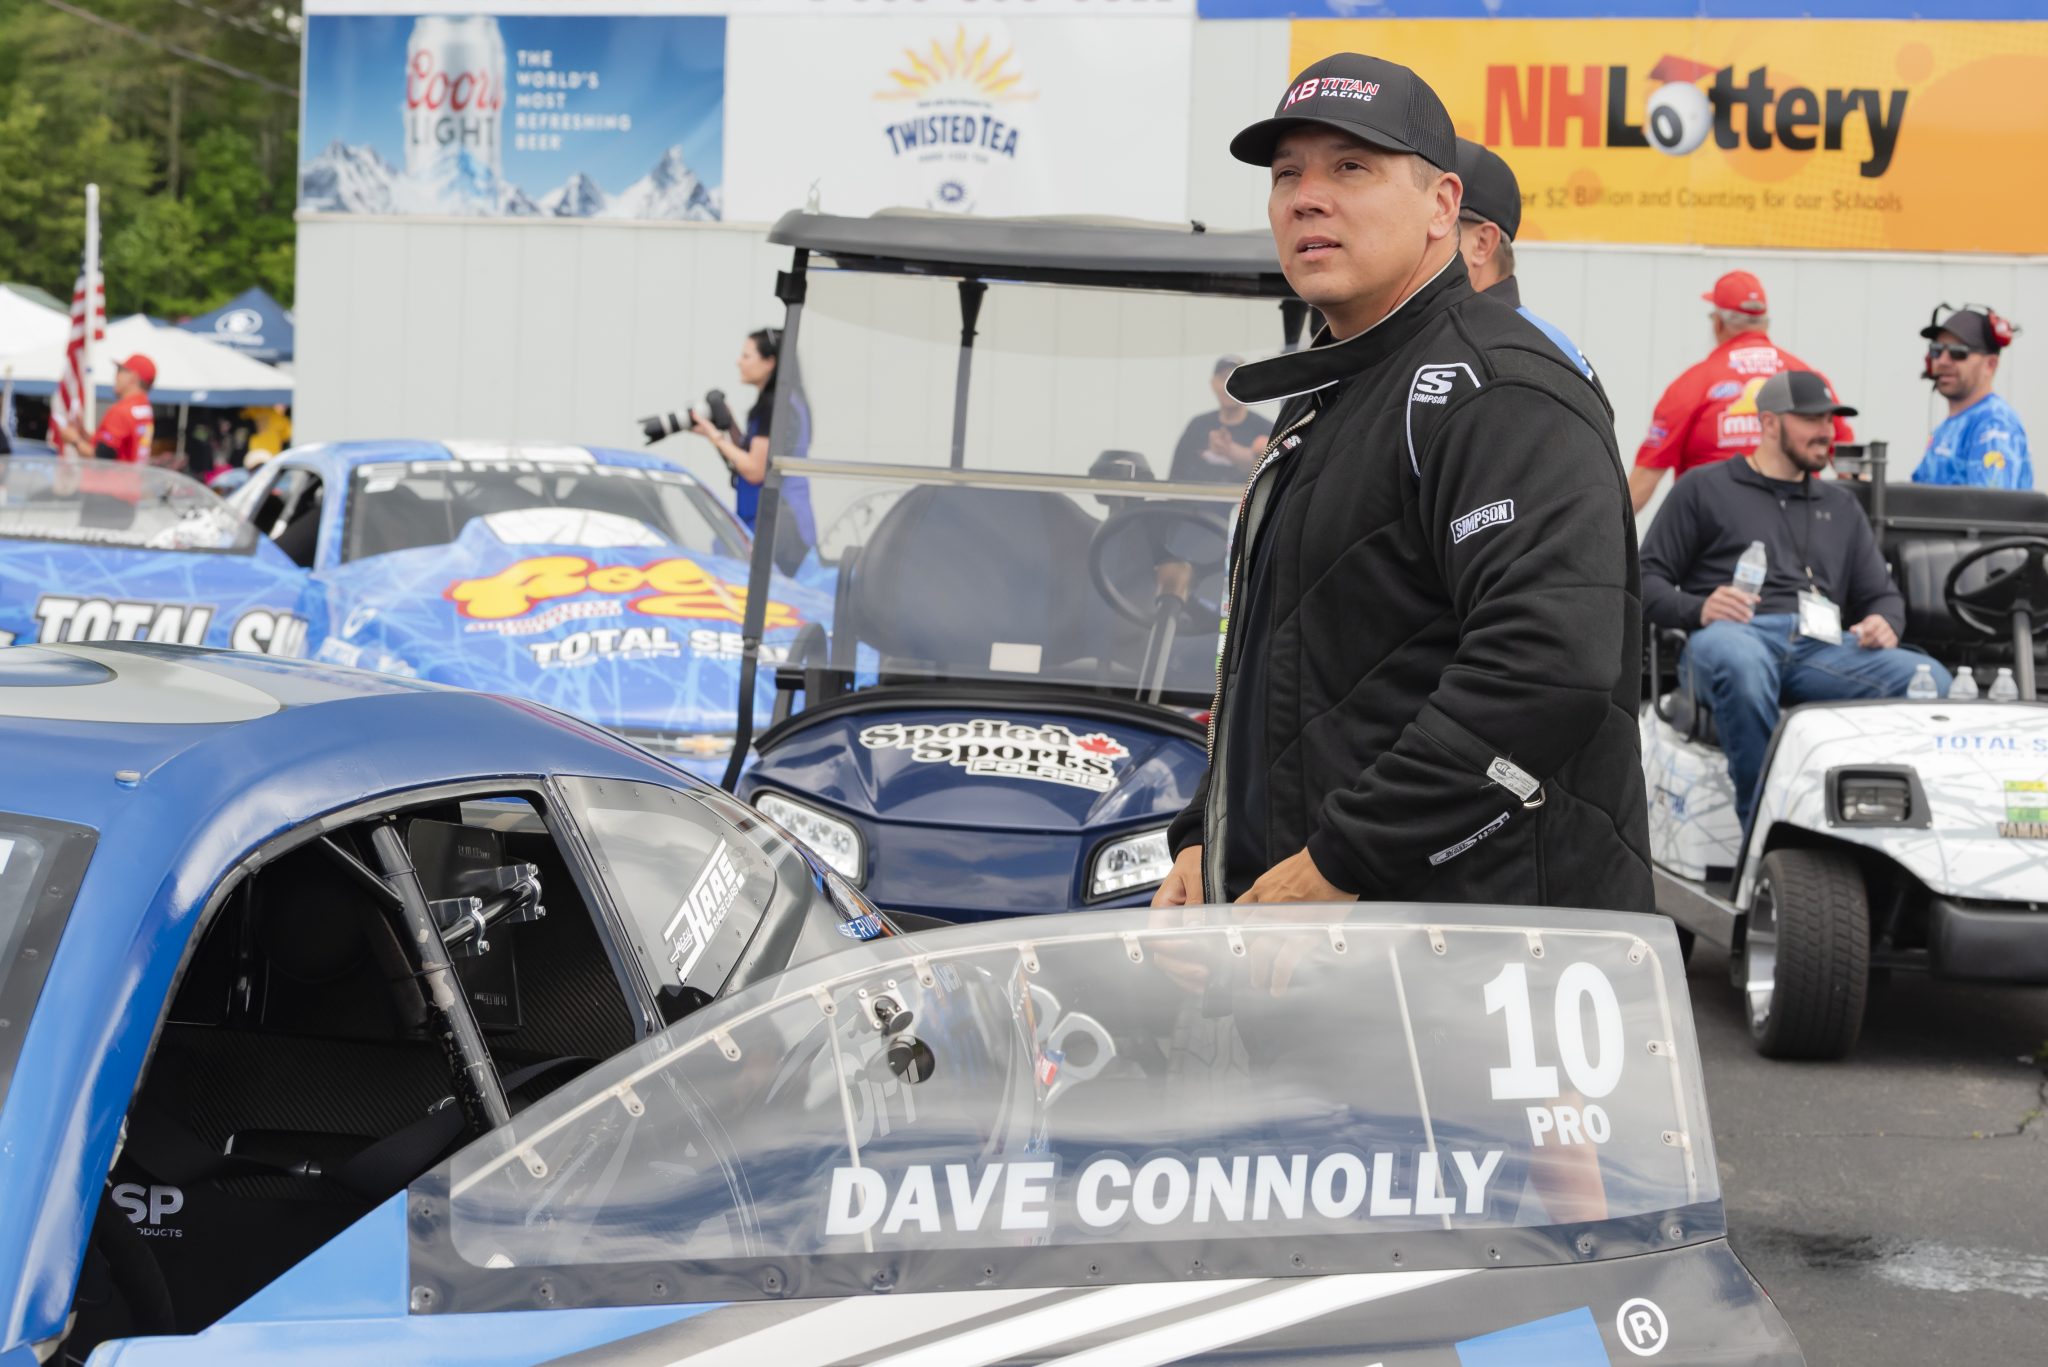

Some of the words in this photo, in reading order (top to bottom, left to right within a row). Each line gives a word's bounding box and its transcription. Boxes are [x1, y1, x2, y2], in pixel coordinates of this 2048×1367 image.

[517, 50, 552, 68] THE
[516, 71, 599, 89] WORLD'S
[1284, 77, 1320, 111] KB
[1321, 77, 1380, 96] TITAN
[516, 92, 566, 109] MOST
[1321, 90, 1372, 102] RACING
[410, 115, 496, 147] LIGHT
[516, 112, 631, 131] REFRESHING
[886, 115, 976, 156] TWISTED
[981, 115, 1018, 158] TEA
[515, 134, 561, 151] BEER
[1545, 187, 1568, 208] $2
[1639, 189, 1671, 209] and
[1832, 188, 1903, 212] Schools
[1412, 393, 1448, 405] SIMPSON
[1455, 504, 1508, 538] SIMPSON
[38, 598, 212, 646] TOTAL
[530, 627, 680, 664] TOTAL
[865, 722, 1071, 746] Spoiled
[1936, 736, 2017, 750] TOTAL
[913, 742, 1115, 776] Sports
[973, 760, 1112, 790] POLARIS
[1483, 962, 1625, 1100] 10
[1526, 1104, 1613, 1147] PRO
[825, 1160, 1056, 1236] DAVE
[1075, 1150, 1504, 1228] CONNOLLY
